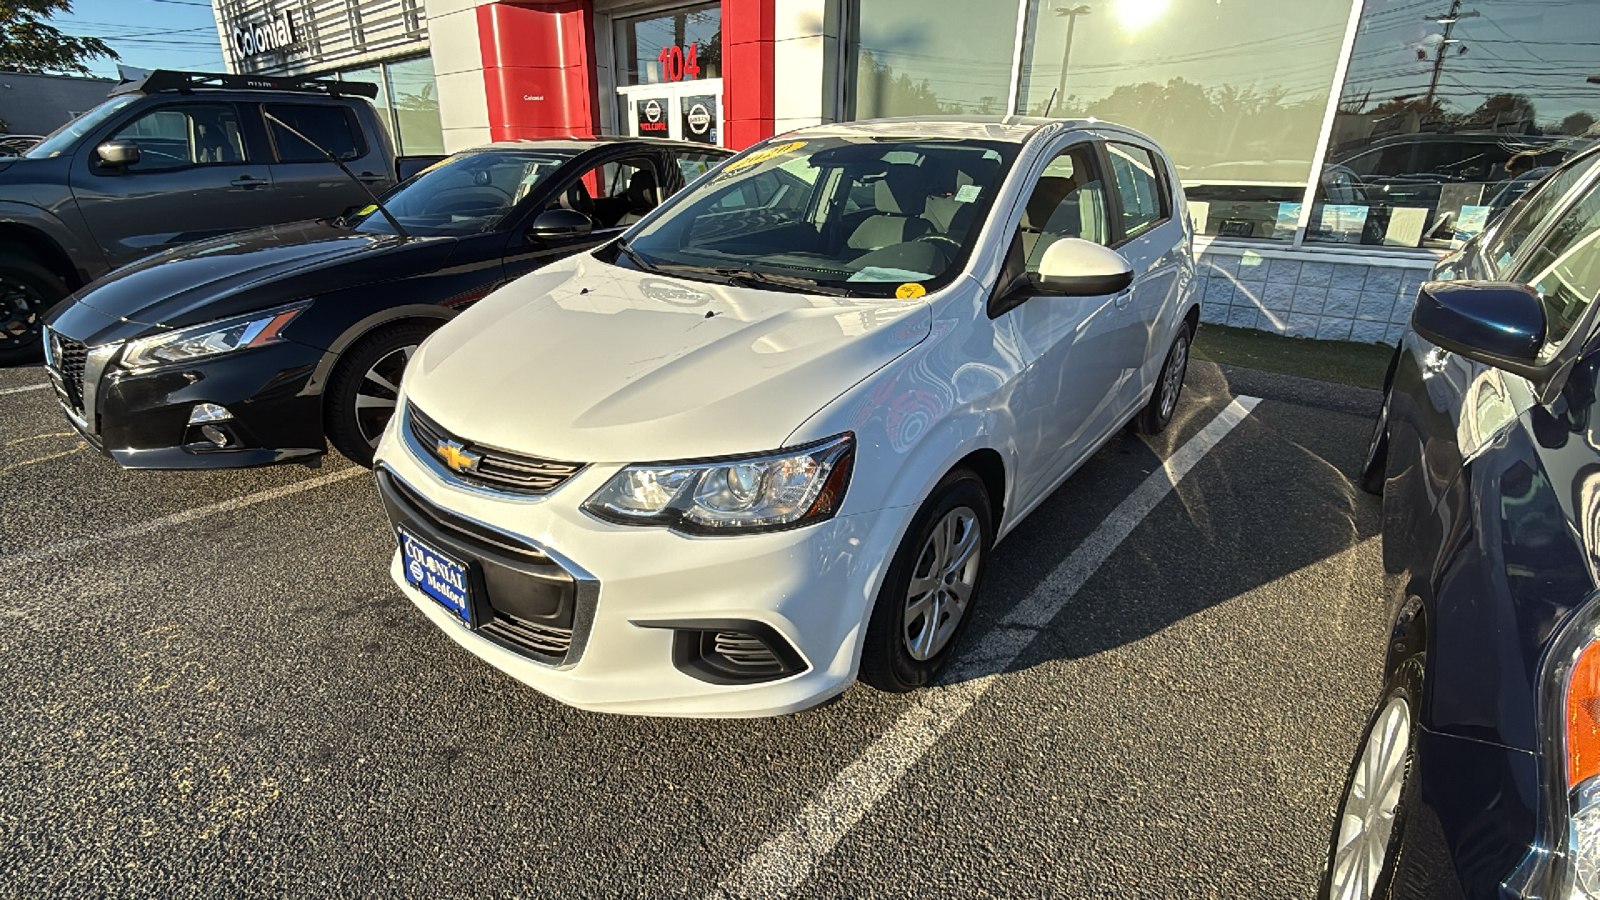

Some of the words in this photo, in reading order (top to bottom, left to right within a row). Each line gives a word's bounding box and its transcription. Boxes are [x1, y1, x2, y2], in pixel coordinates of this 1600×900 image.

[233, 9, 292, 59] Colonial
[658, 42, 700, 83] 104
[640, 122, 667, 131] WELCOME
[405, 538, 466, 593] COLONIAL
[426, 571, 465, 609] Medford
